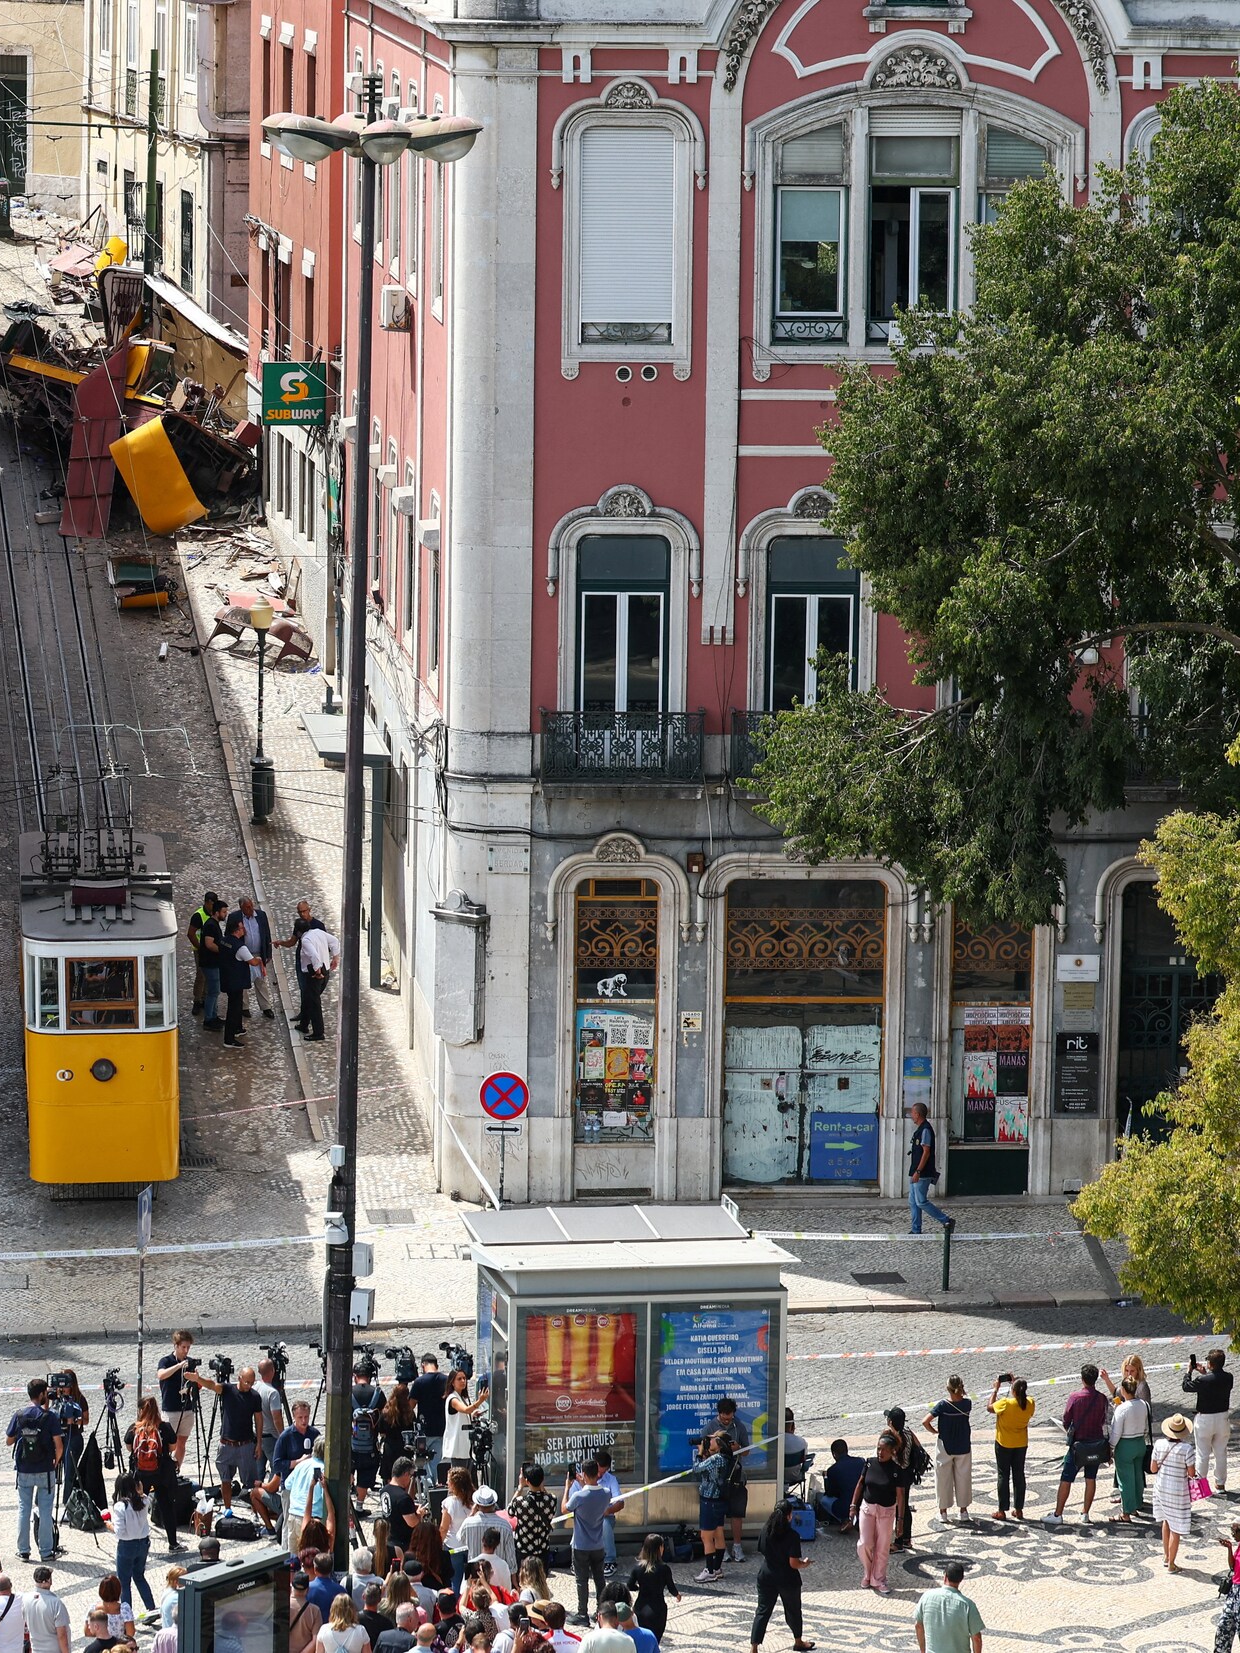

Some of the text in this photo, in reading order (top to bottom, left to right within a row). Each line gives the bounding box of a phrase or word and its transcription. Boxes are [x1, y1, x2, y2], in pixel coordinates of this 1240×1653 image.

[266, 408, 323, 420] SUBWAY
[1066, 1036, 1088, 1050] rit
[1000, 1056, 1026, 1065] MANAS
[968, 1101, 994, 1110] MANAS
[814, 1122, 874, 1132] Rent-a-car
[718, 1345, 731, 1354] JOÃO
[547, 1430, 615, 1451] SER PORTUGUÊS
[535, 1450, 551, 1466] NÃO
[554, 1451, 564, 1464] SE
